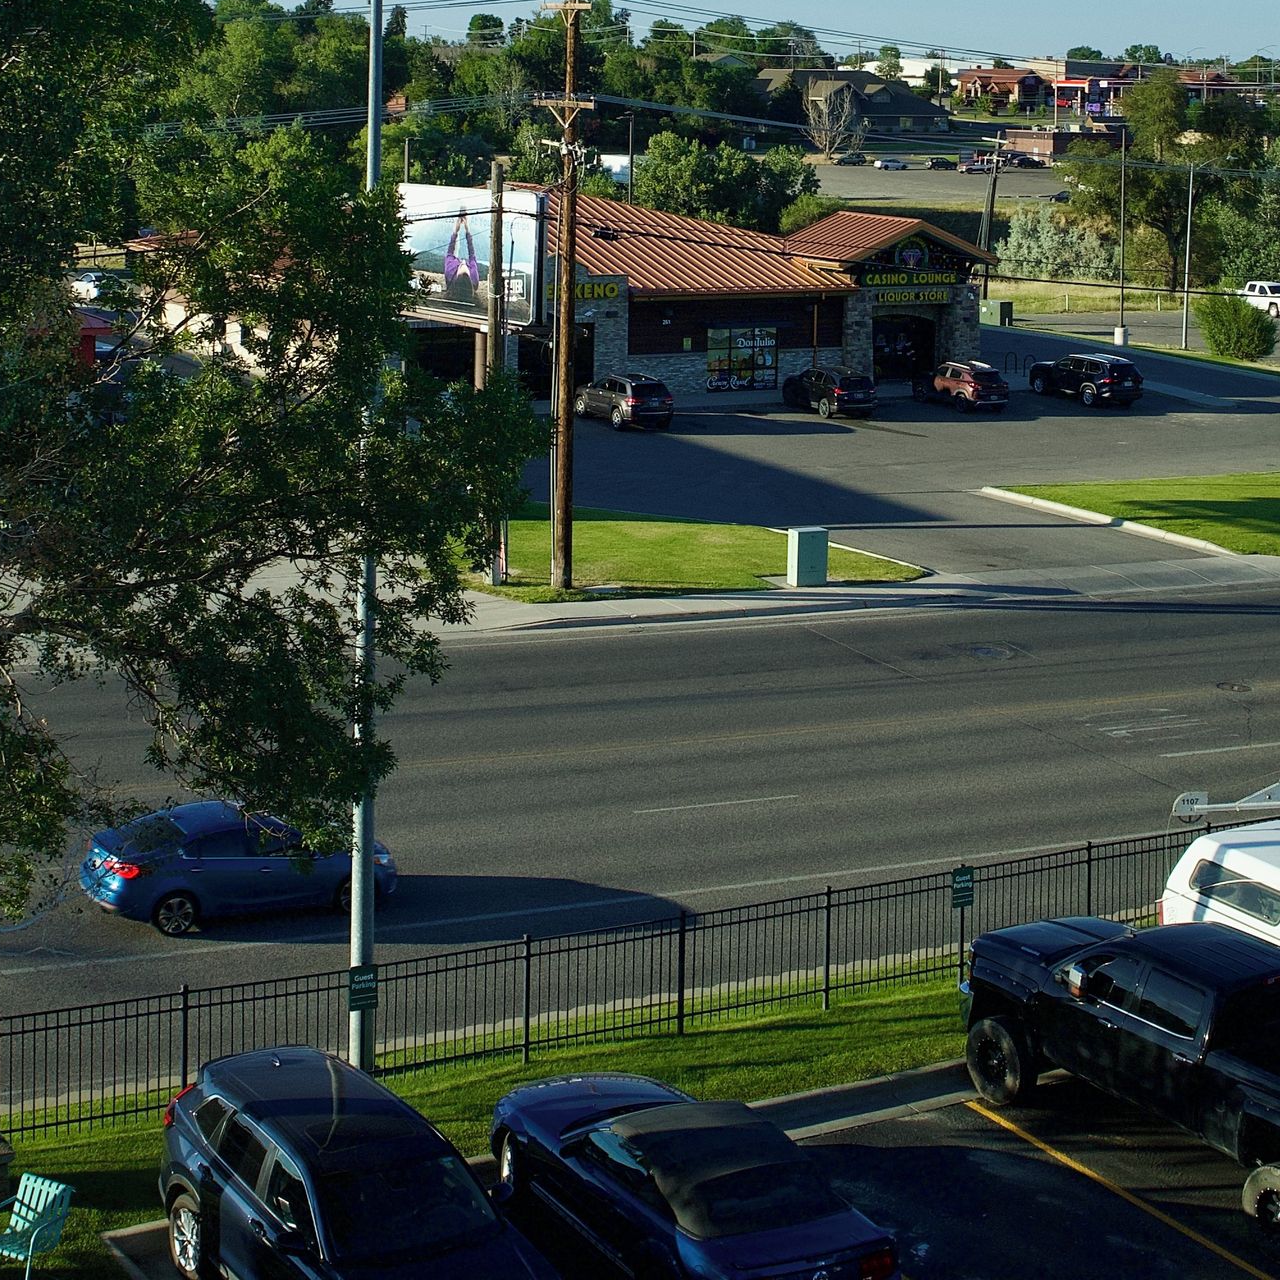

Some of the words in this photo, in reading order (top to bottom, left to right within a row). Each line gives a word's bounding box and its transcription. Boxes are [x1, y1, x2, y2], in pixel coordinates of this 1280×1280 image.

[866, 273, 908, 285] CASINO
[913, 273, 956, 284] LOUNGE
[575, 282, 619, 299] KENO
[878, 291, 915, 302] LIQUOR
[919, 291, 948, 301] STORE
[955, 874, 971, 882] Guest
[953, 881, 973, 889] Parking
[354, 973, 374, 982] Guest
[351, 981, 376, 990] Parking
